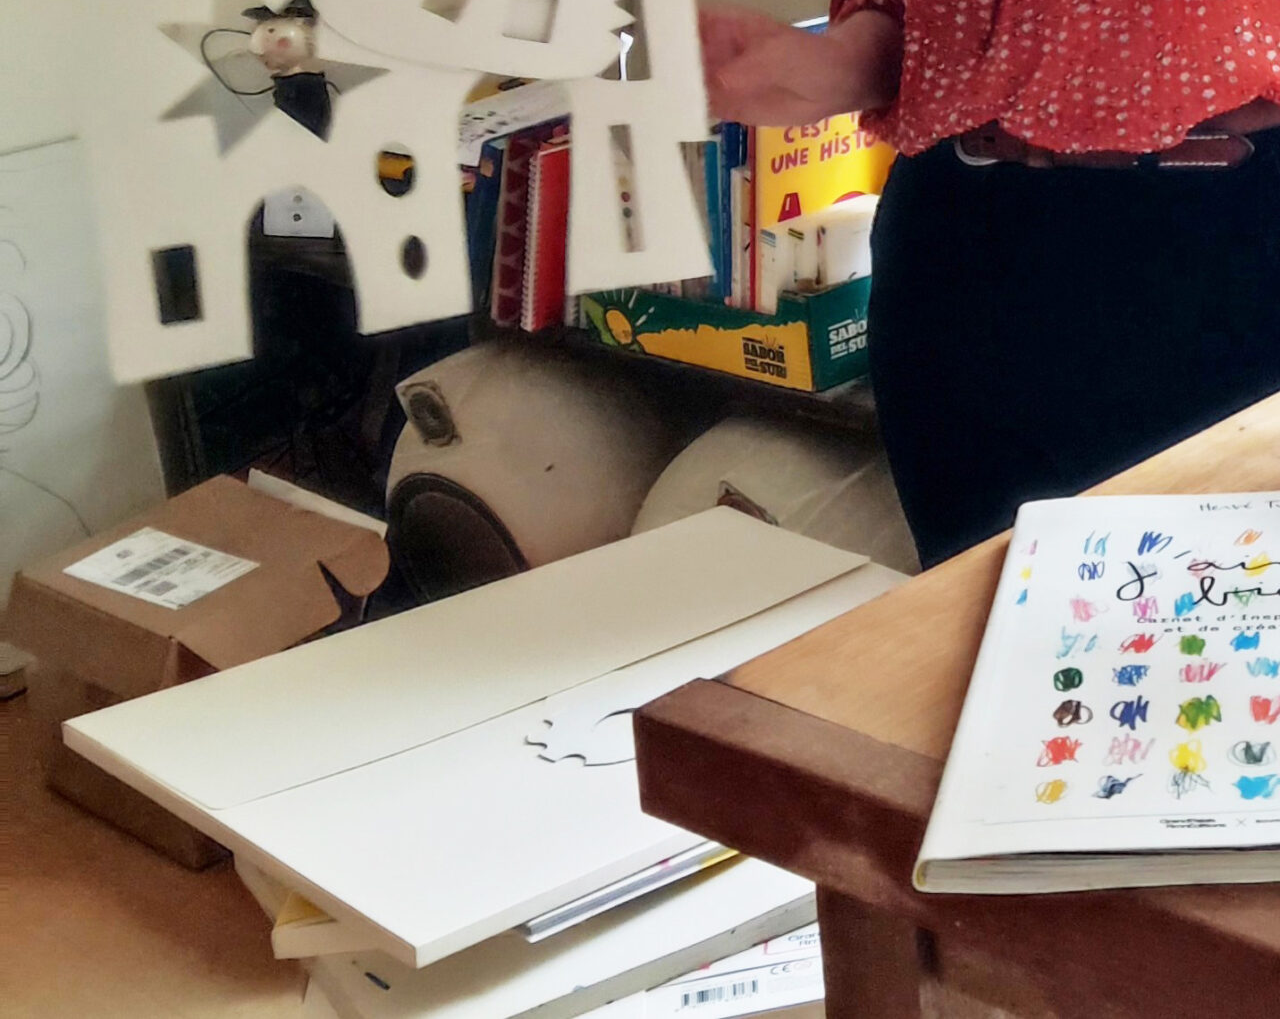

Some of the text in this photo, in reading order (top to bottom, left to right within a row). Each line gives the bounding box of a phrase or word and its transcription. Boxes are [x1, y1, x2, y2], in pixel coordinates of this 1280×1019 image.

[783, 117, 830, 144] CEST
[771, 129, 877, 174] UNE HiSTO
[829, 320, 868, 345] SABO
[848, 334, 868, 353] SU
[743, 342, 786, 364] SABOR
[1198, 624, 1220, 632] de
